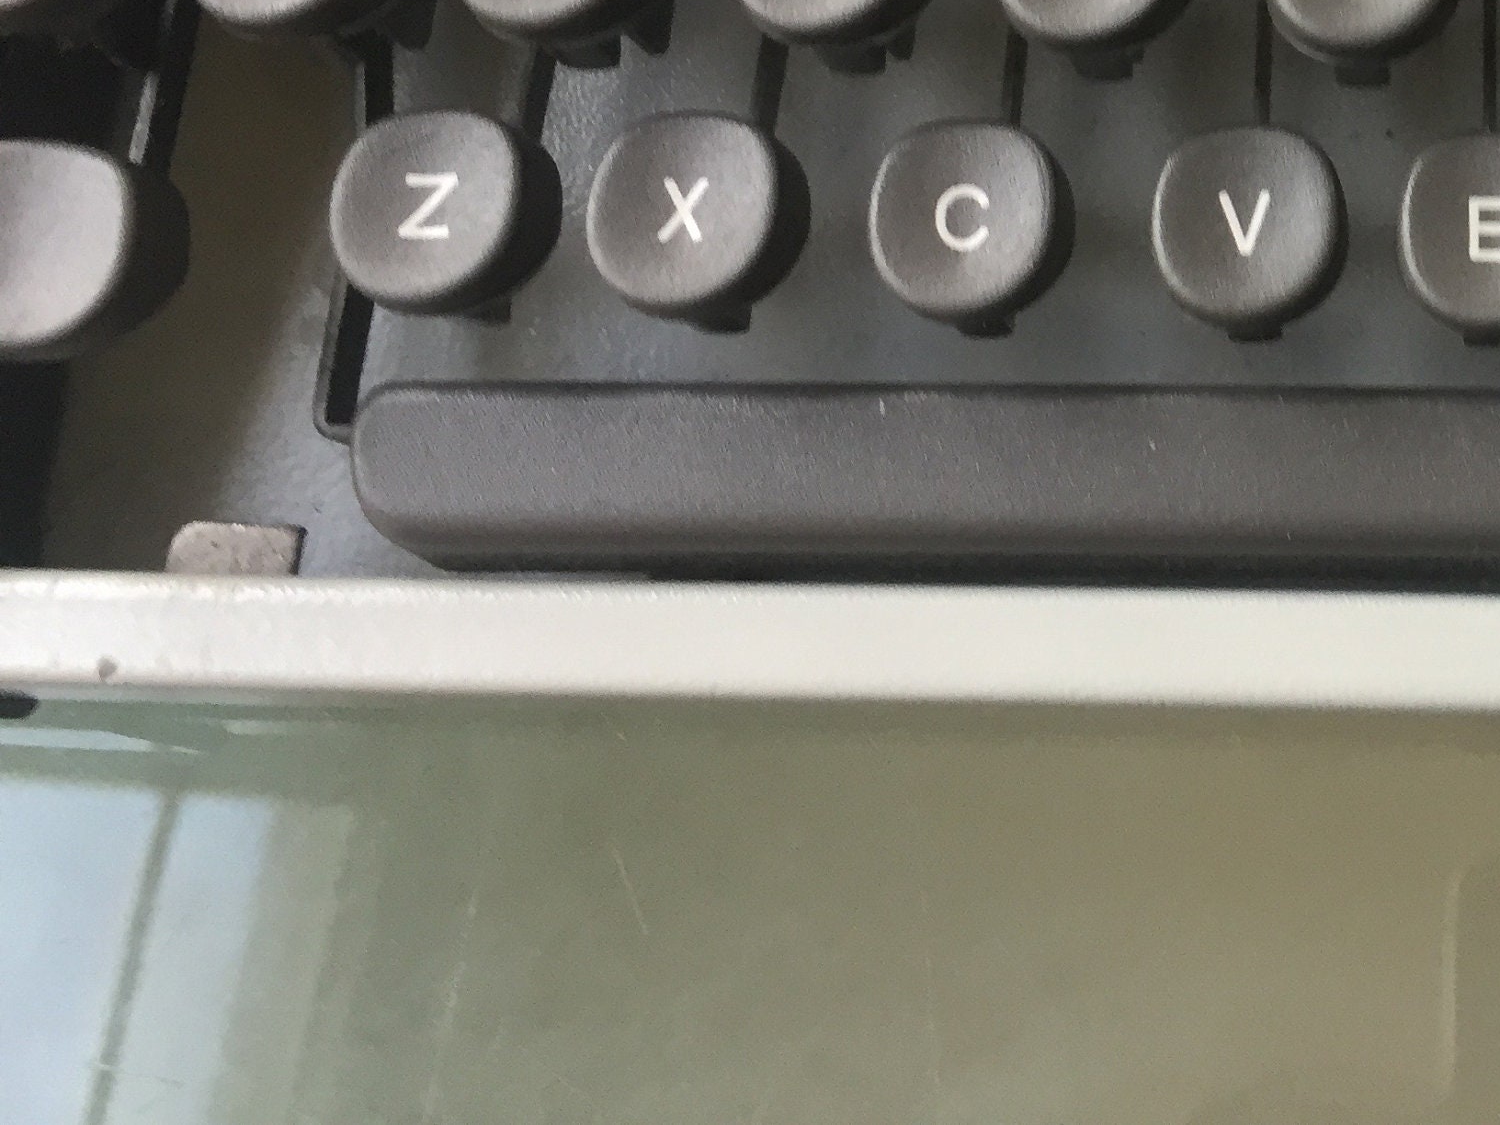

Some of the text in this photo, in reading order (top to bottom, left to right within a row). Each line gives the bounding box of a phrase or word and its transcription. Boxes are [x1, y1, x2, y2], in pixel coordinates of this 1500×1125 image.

[397, 172, 459, 240] Z
[657, 177, 709, 243] X
[935, 183, 989, 253] C
[1219, 189, 1270, 257] V
